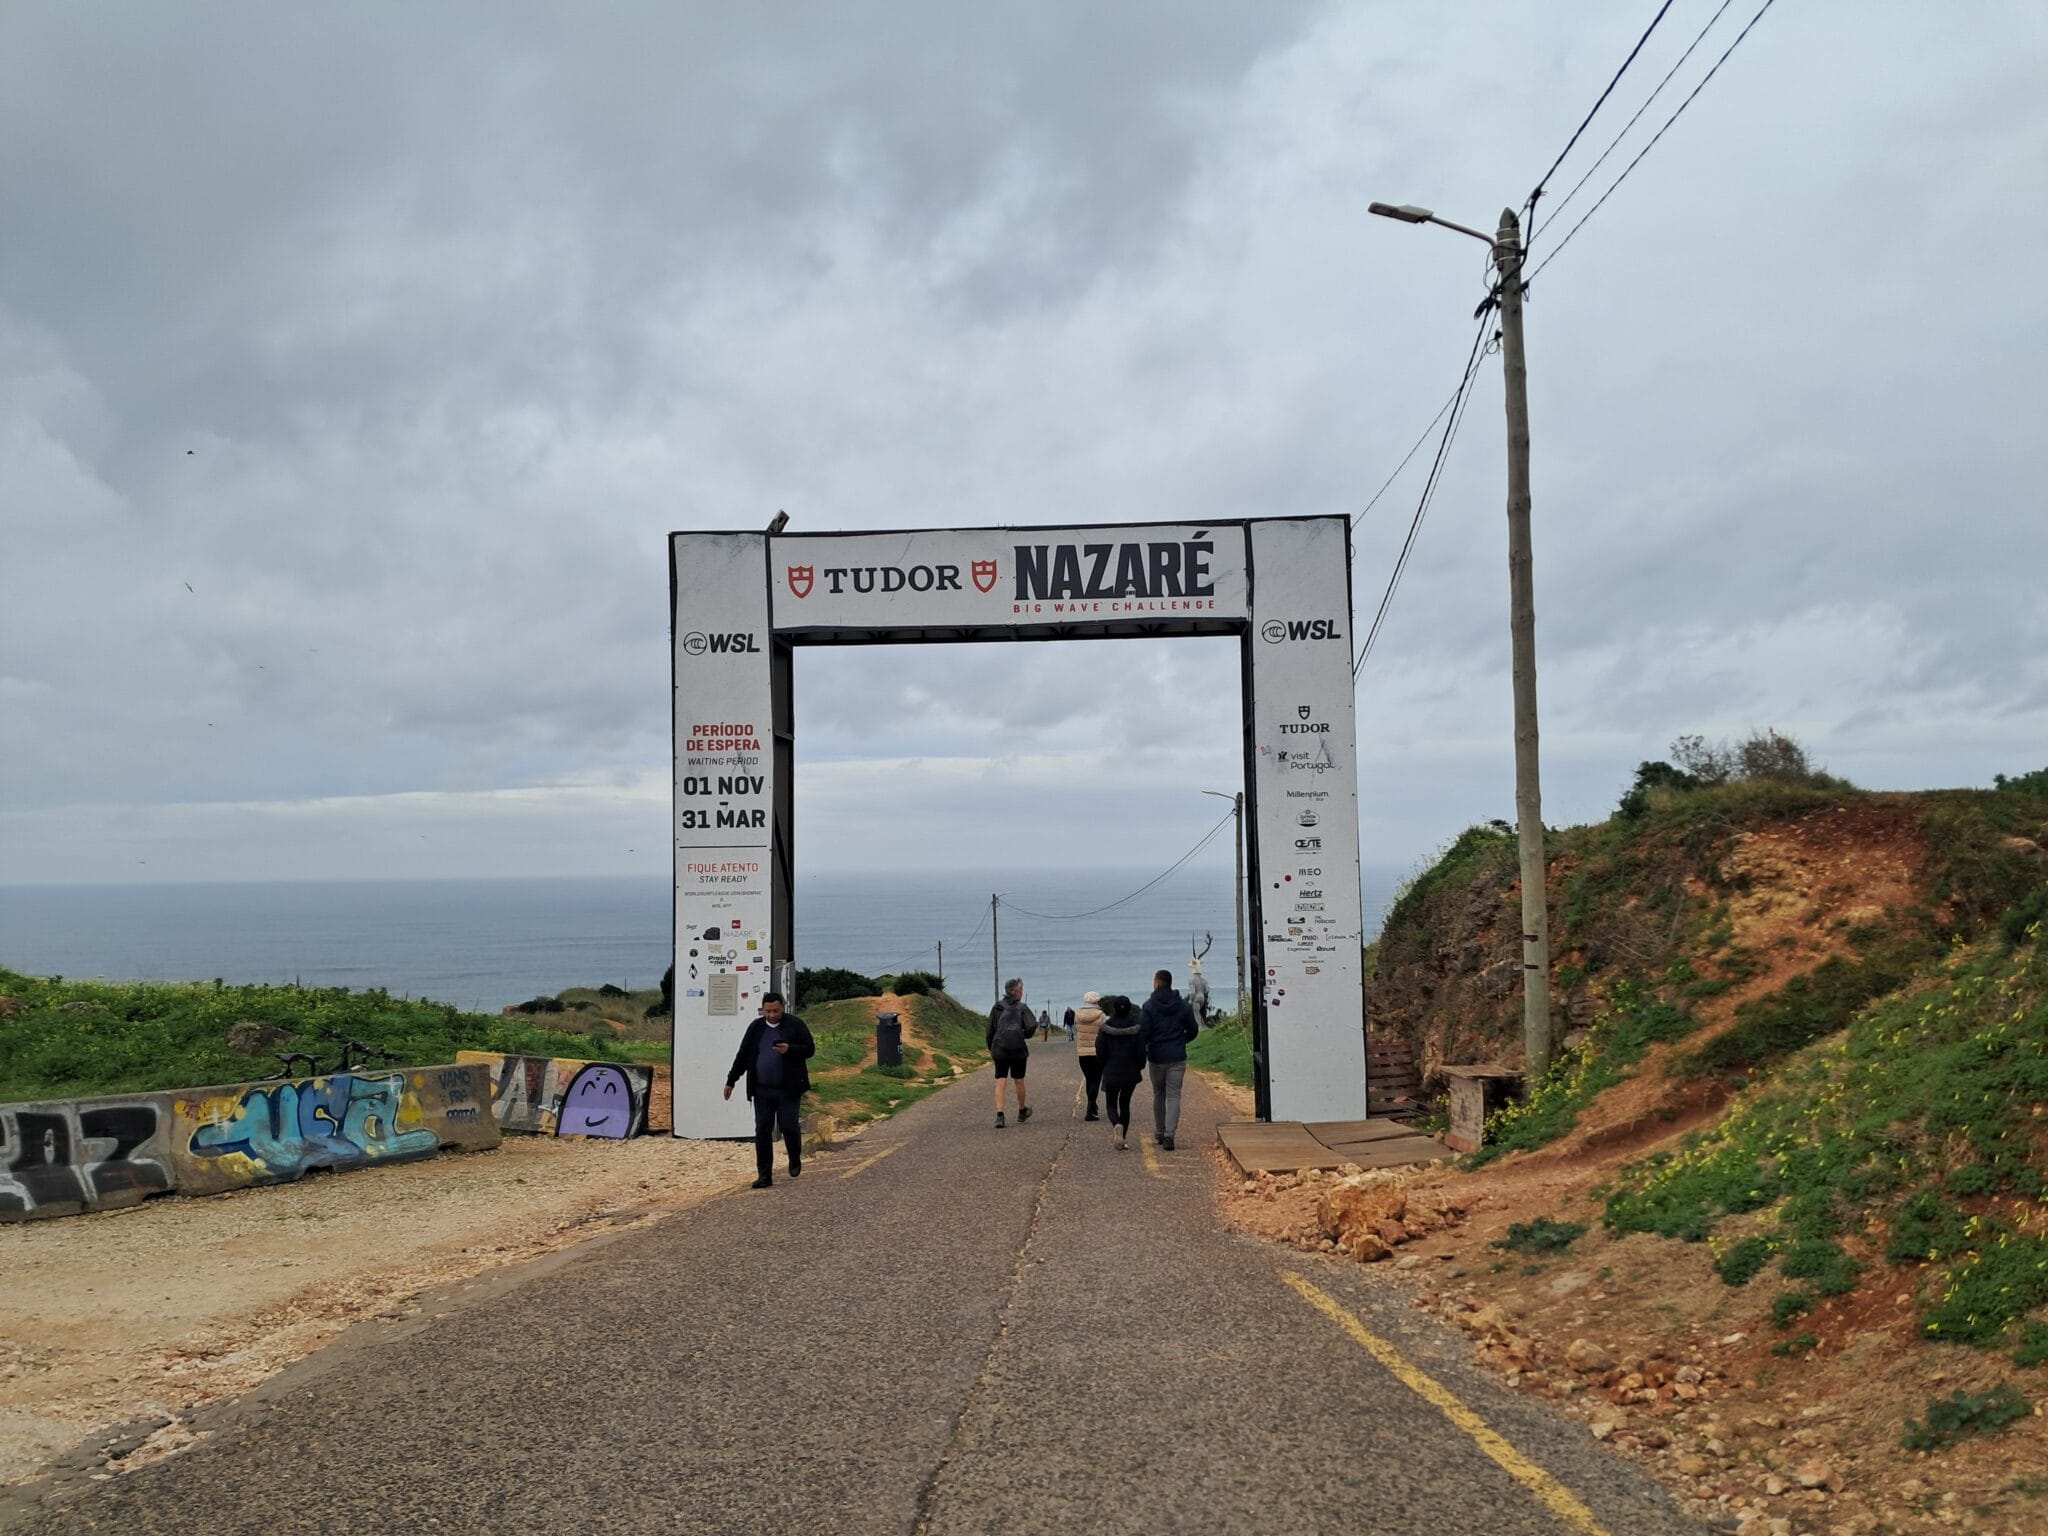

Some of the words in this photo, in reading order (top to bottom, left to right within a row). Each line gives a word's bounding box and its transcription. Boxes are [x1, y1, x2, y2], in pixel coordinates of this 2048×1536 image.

[823, 565, 963, 594] TUDOR
[1013, 530, 1215, 602] NAZARÉ
[1013, 603, 1042, 614] BIG
[1054, 602, 1101, 613] WAVE
[1112, 600, 1217, 613] CHALLENGE
[1288, 619, 1341, 641] WSL
[708, 633, 760, 653] WSL
[692, 721, 754, 737] PERÍODO
[1279, 723, 1331, 734] TUDOR
[686, 740, 704, 752] DE
[707, 739, 761, 752] ESPERA
[688, 757, 725, 766] WAITING
[726, 756, 759, 766] PERIOD
[1290, 751, 1310, 760] visit
[1290, 761, 1335, 774] Portugal
[683, 776, 713, 796] 01
[718, 775, 765, 795] NOV
[1286, 790, 1329, 798] Millennium
[682, 809, 711, 829] 31
[716, 808, 766, 829] MAR
[687, 863, 718, 874] FIQUE
[720, 862, 759, 873] ATENTO
[698, 875, 719, 883] STAY
[720, 875, 748, 883] READY
[1299, 889, 1323, 898] Hertz
